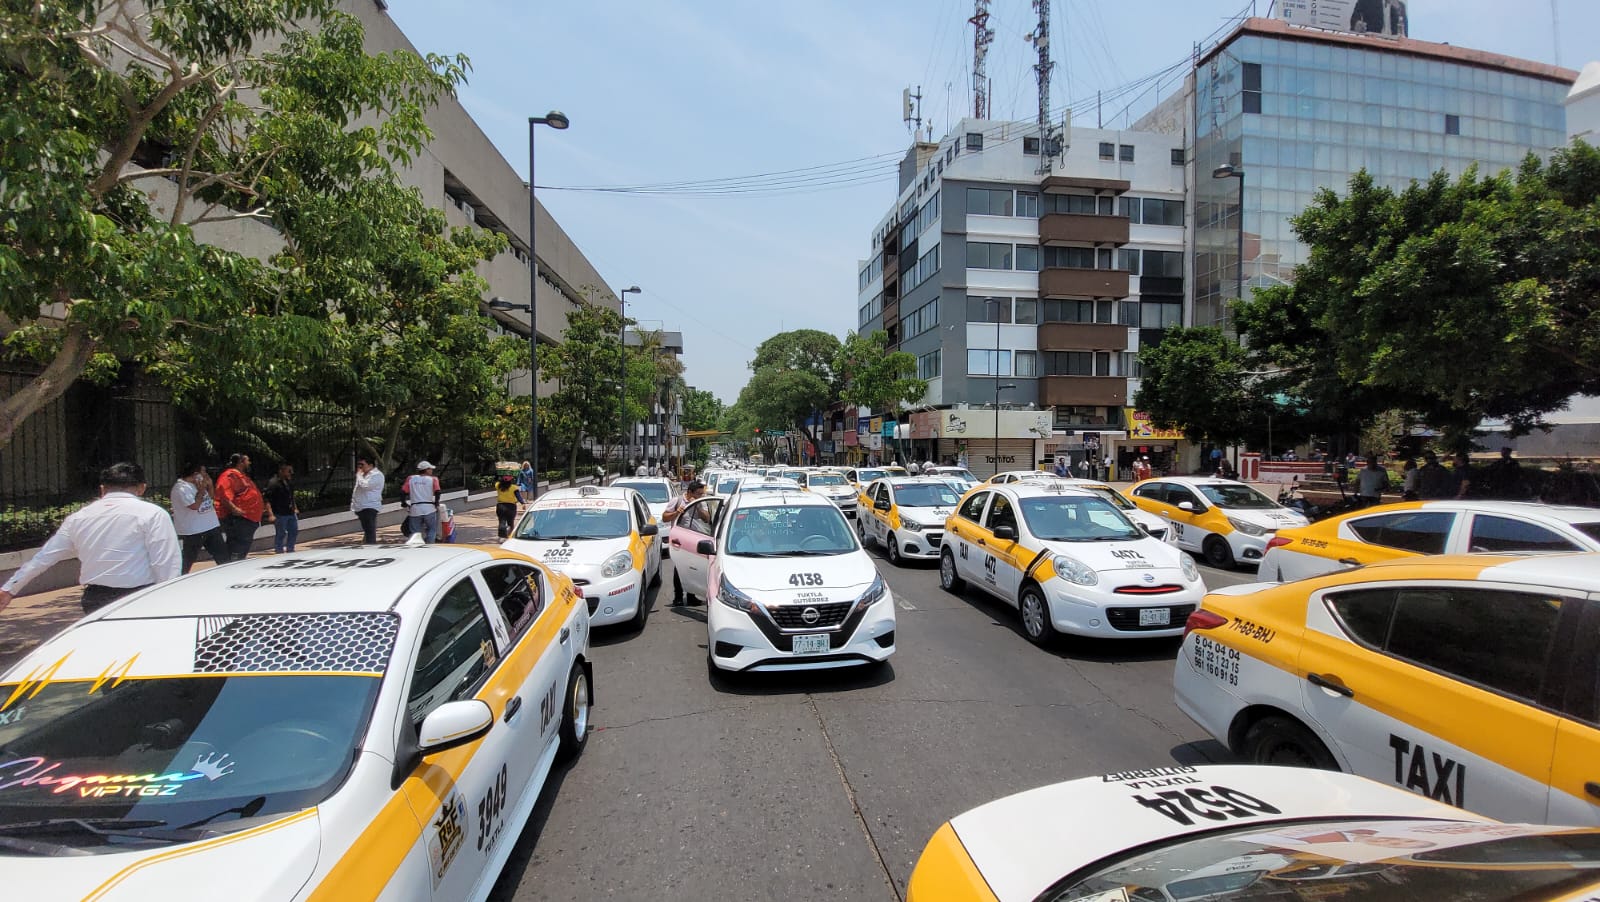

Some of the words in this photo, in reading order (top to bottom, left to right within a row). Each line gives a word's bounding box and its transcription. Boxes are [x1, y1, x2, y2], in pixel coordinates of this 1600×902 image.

[262, 557, 396, 570] 3949
[543, 548, 575, 557] 2002
[1110, 549, 1145, 560] 4472
[984, 553, 996, 575] 4472
[789, 573, 824, 586] 4138
[1195, 635, 1201, 645] 6
[1202, 638, 1213, 650] 04
[1214, 643, 1226, 657] 04
[1228, 649, 1240, 661] 04
[1206, 650, 1214, 663] 32
[1221, 657, 1229, 669] 23
[1231, 662, 1239, 674] 15
[1206, 663, 1214, 674] 16
[1214, 667, 1219, 677] 0
[1220, 669, 1228, 681] 91
[1229, 673, 1238, 686] 93
[540, 680, 557, 737] TAXI
[1389, 733, 1466, 809] TAXI
[80, 784, 183, 798] VIPTGZ
[1124, 776, 1203, 790] TUXTLA
[478, 763, 507, 852] 3949
[1131, 785, 1282, 826] 0524
